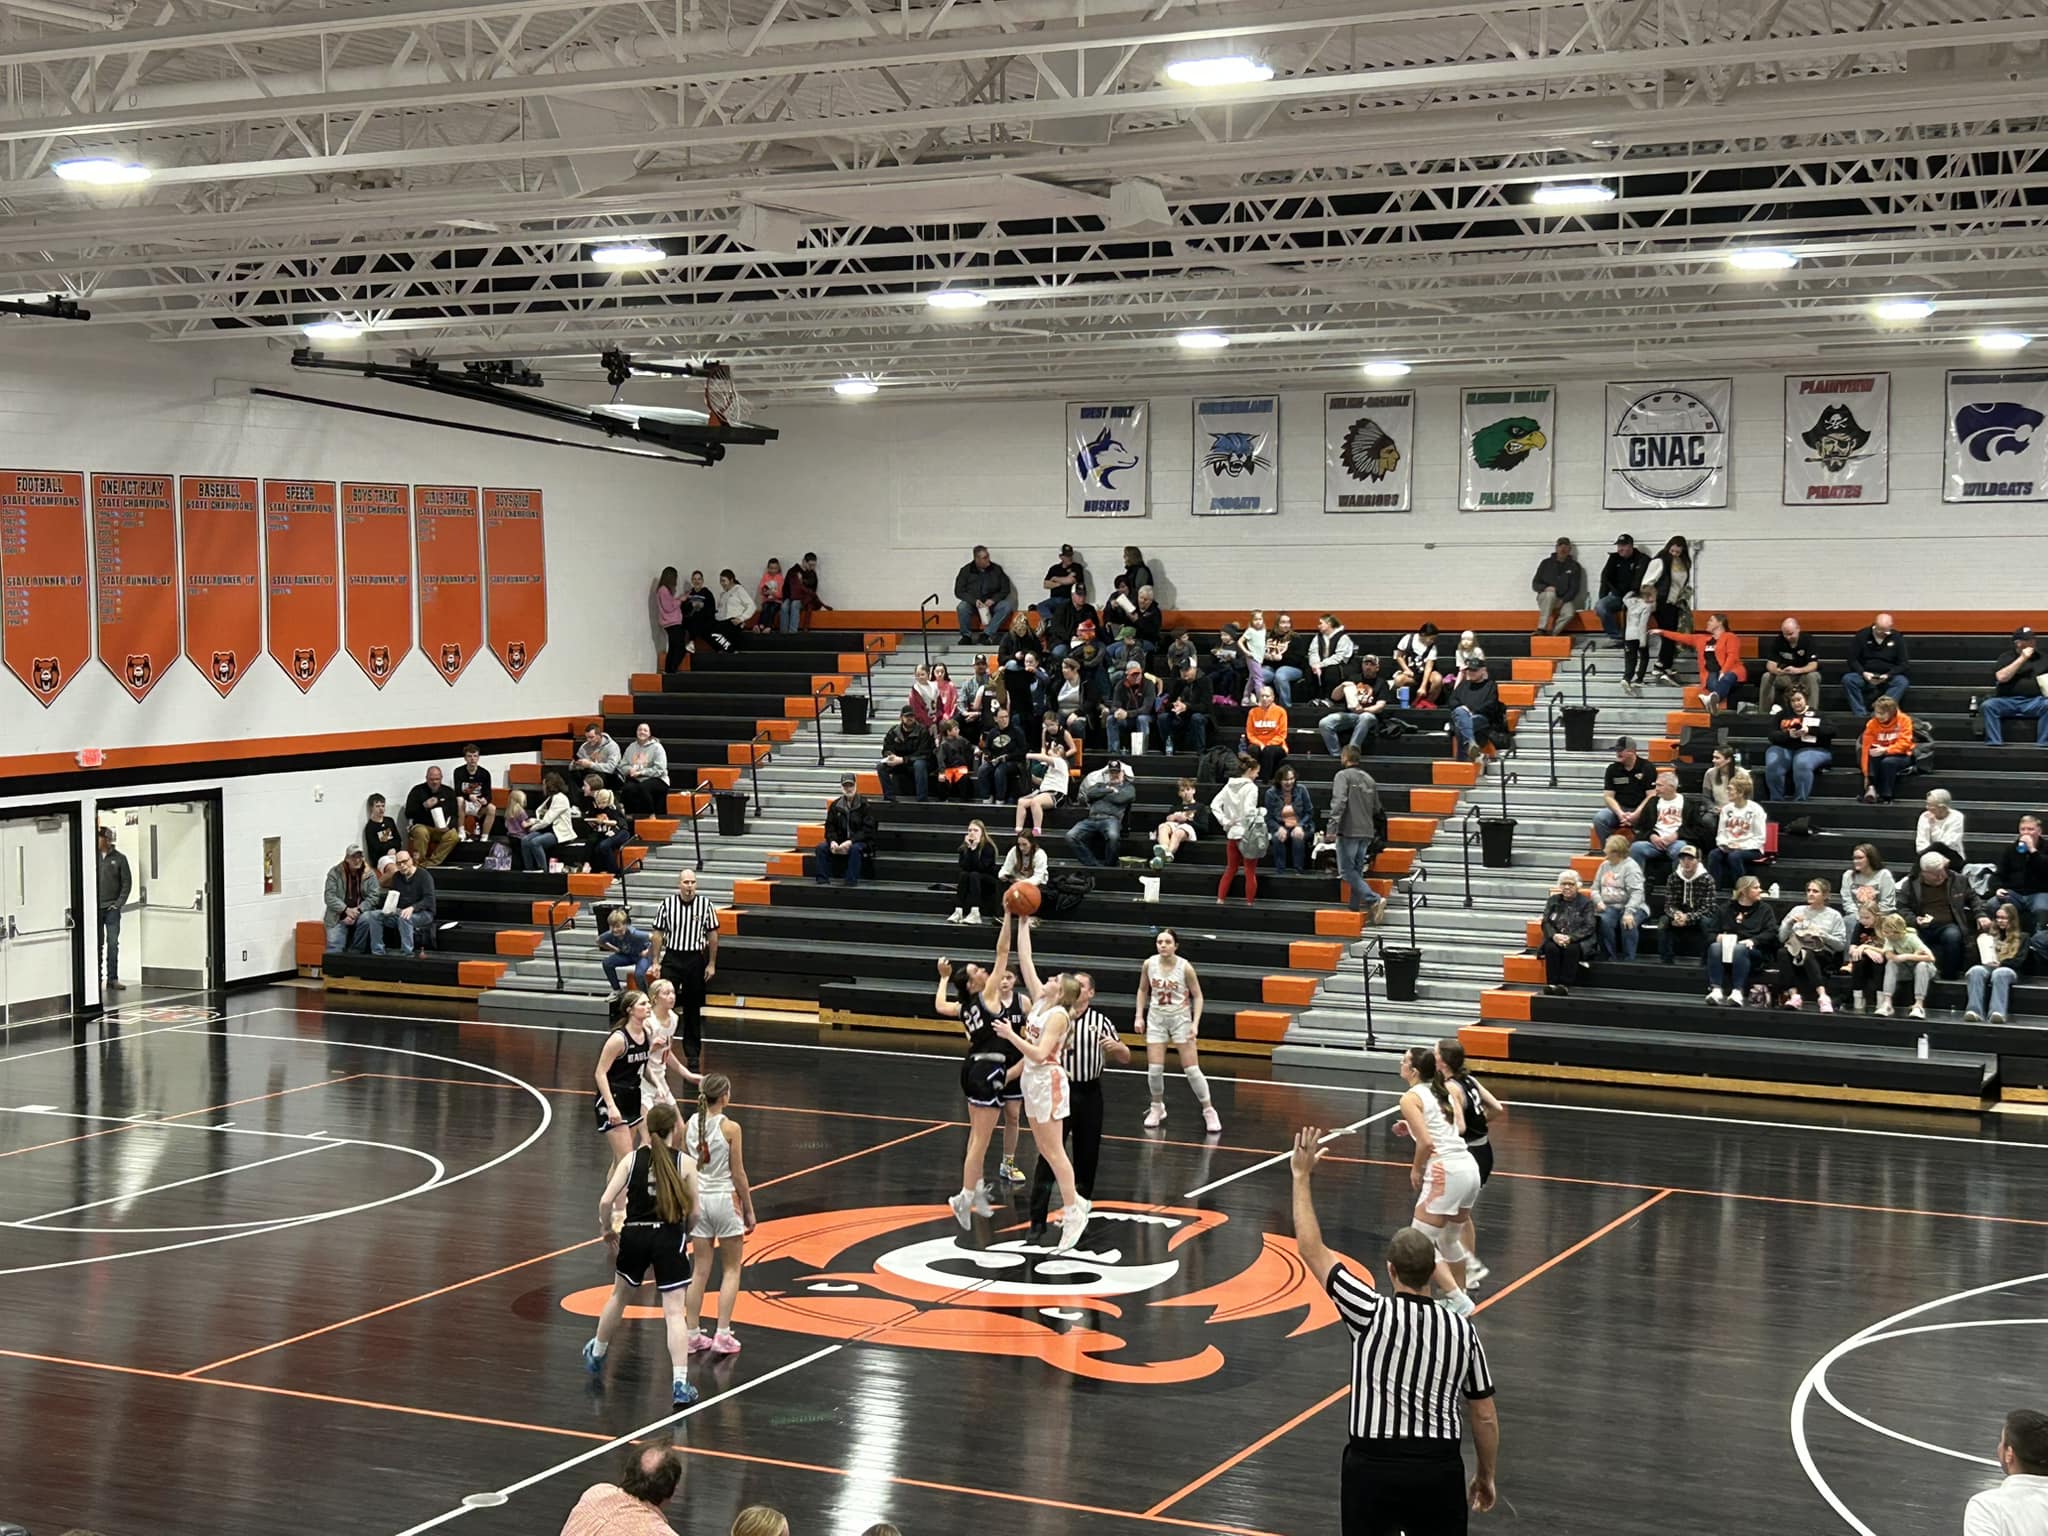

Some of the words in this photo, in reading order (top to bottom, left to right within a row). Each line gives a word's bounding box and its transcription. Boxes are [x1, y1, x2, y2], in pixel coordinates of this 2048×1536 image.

[1629, 436, 1705, 467] GNAC
[16, 476, 64, 493] FOOTBALL
[100, 480, 118, 494] ONE
[121, 480, 138, 496] ACT
[140, 481, 164, 496] PLAY
[198, 483, 240, 498] BASEBALL
[1962, 482, 2033, 496] WILDCATS
[286, 486, 314, 500] SPEECH
[1480, 492, 1534, 504] FALCONS
[1806, 485, 1862, 499] PIRATES
[2, 496, 26, 504] STATE
[30, 496, 80, 506] CHAMPIONS
[122, 498, 170, 510] CHAMPIONS
[1084, 500, 1130, 512] HUSKIES
[1338, 494, 1400, 507] WARRIORS
[6, 576, 30, 586] STATE
[1158, 992, 1172, 1005] 21
[964, 1004, 984, 1032] 22
